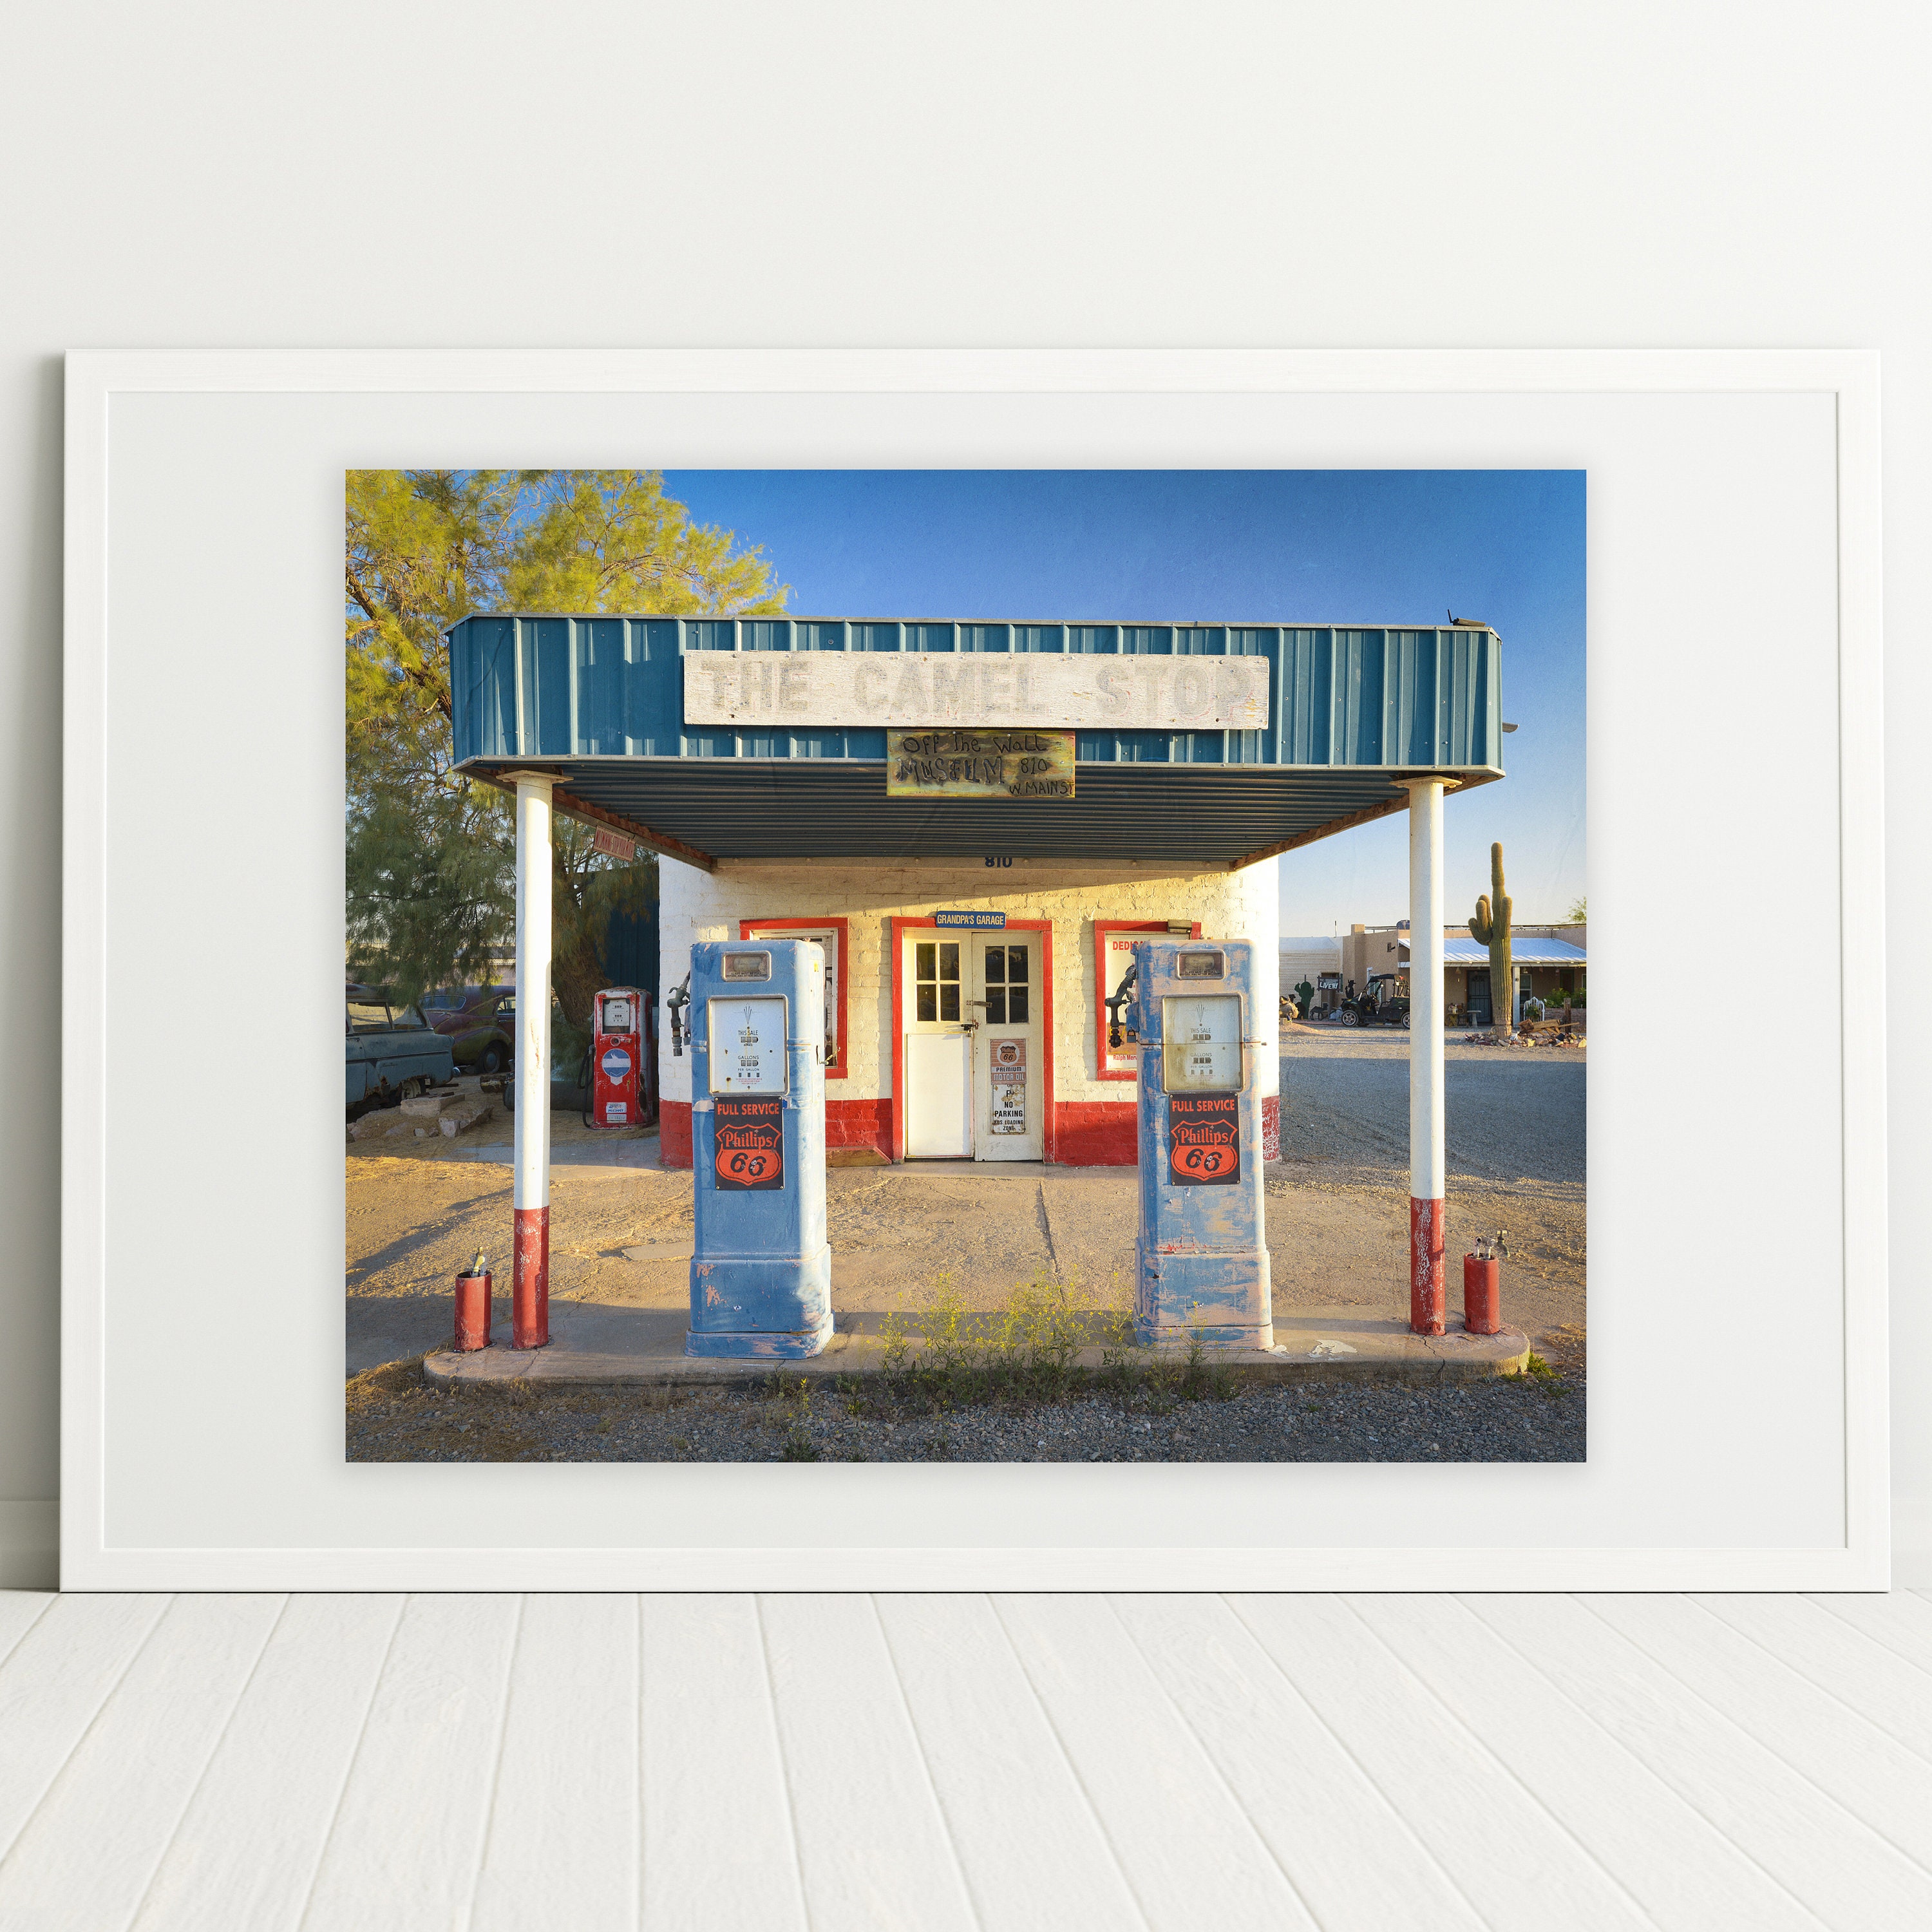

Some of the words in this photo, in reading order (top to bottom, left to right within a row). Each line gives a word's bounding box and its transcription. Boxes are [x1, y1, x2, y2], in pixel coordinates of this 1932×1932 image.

[701, 660, 810, 712] THE
[853, 659, 1048, 717] CAMEL
[1095, 663, 1253, 720] STOP
[1021, 757, 1048, 774] 810
[937, 914, 974, 925] GRANDPA'S
[976, 915, 1004, 925] GARAGE
[1113, 941, 1143, 950] DEDI
[717, 1103, 739, 1115] FULL
[741, 1103, 779, 1115] SERVICE
[1172, 1100, 1195, 1112] FULL
[1197, 1099, 1235, 1112] SERVICE
[722, 1131, 773, 1150] Phillips
[1177, 1127, 1229, 1146] Phillips
[730, 1152, 767, 1177] 66
[1186, 1148, 1223, 1172] 66
